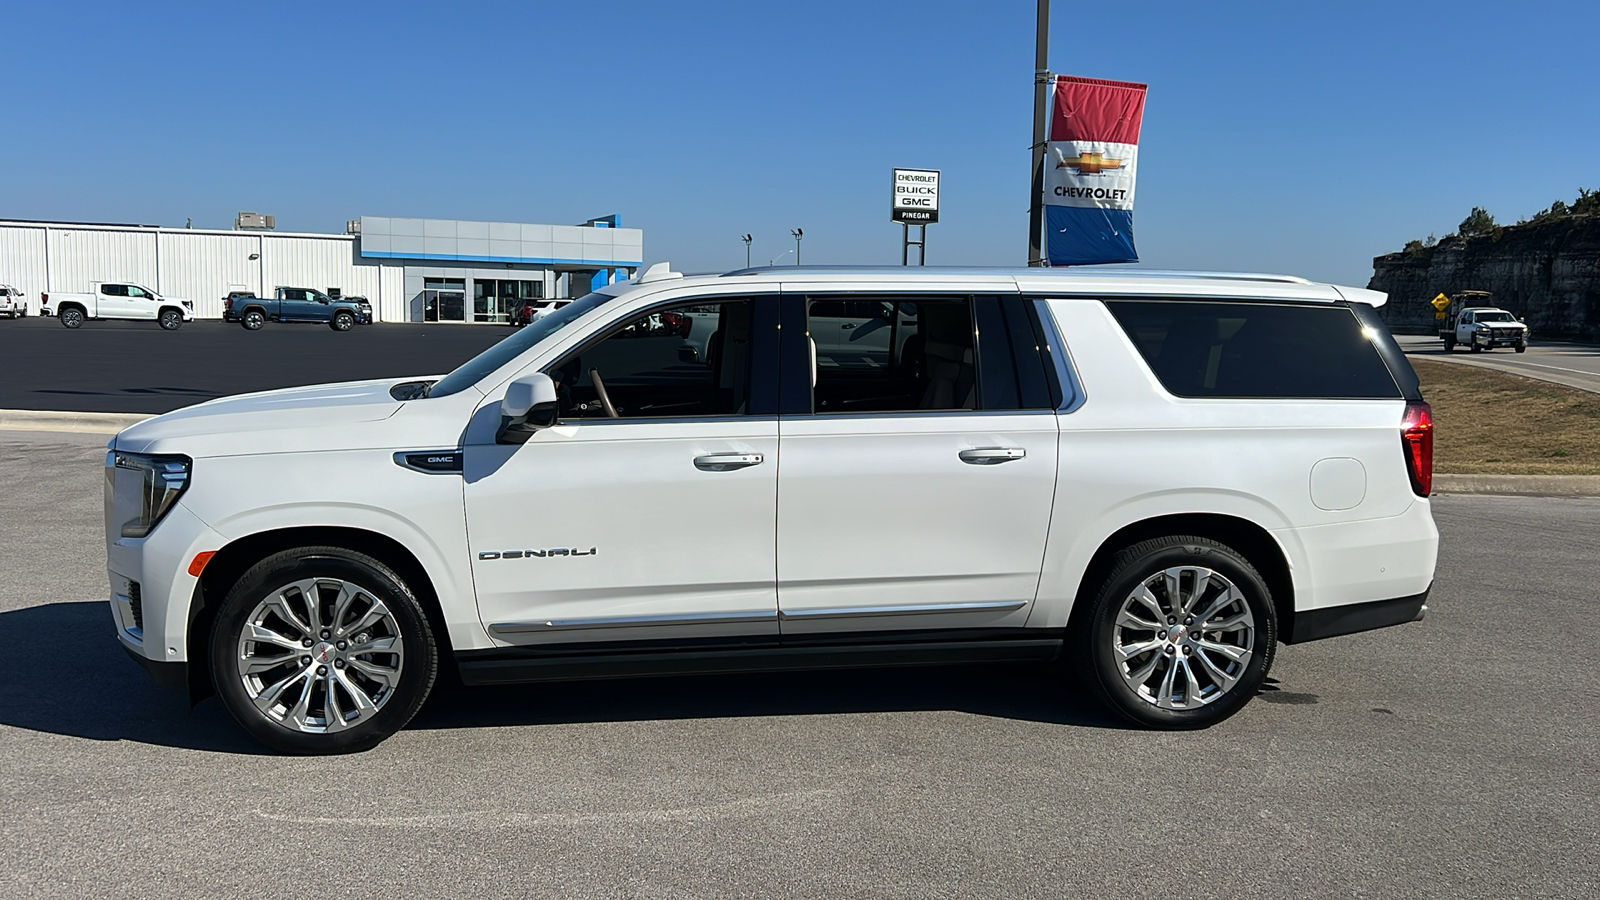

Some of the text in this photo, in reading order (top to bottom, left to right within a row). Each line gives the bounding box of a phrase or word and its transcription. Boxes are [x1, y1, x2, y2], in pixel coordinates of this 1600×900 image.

[898, 174, 936, 183] CHEVROLET
[897, 186, 936, 195] BUICK
[1054, 186, 1126, 200] CHEVROLET
[902, 198, 931, 206] GMC
[479, 547, 597, 560] DENALI
